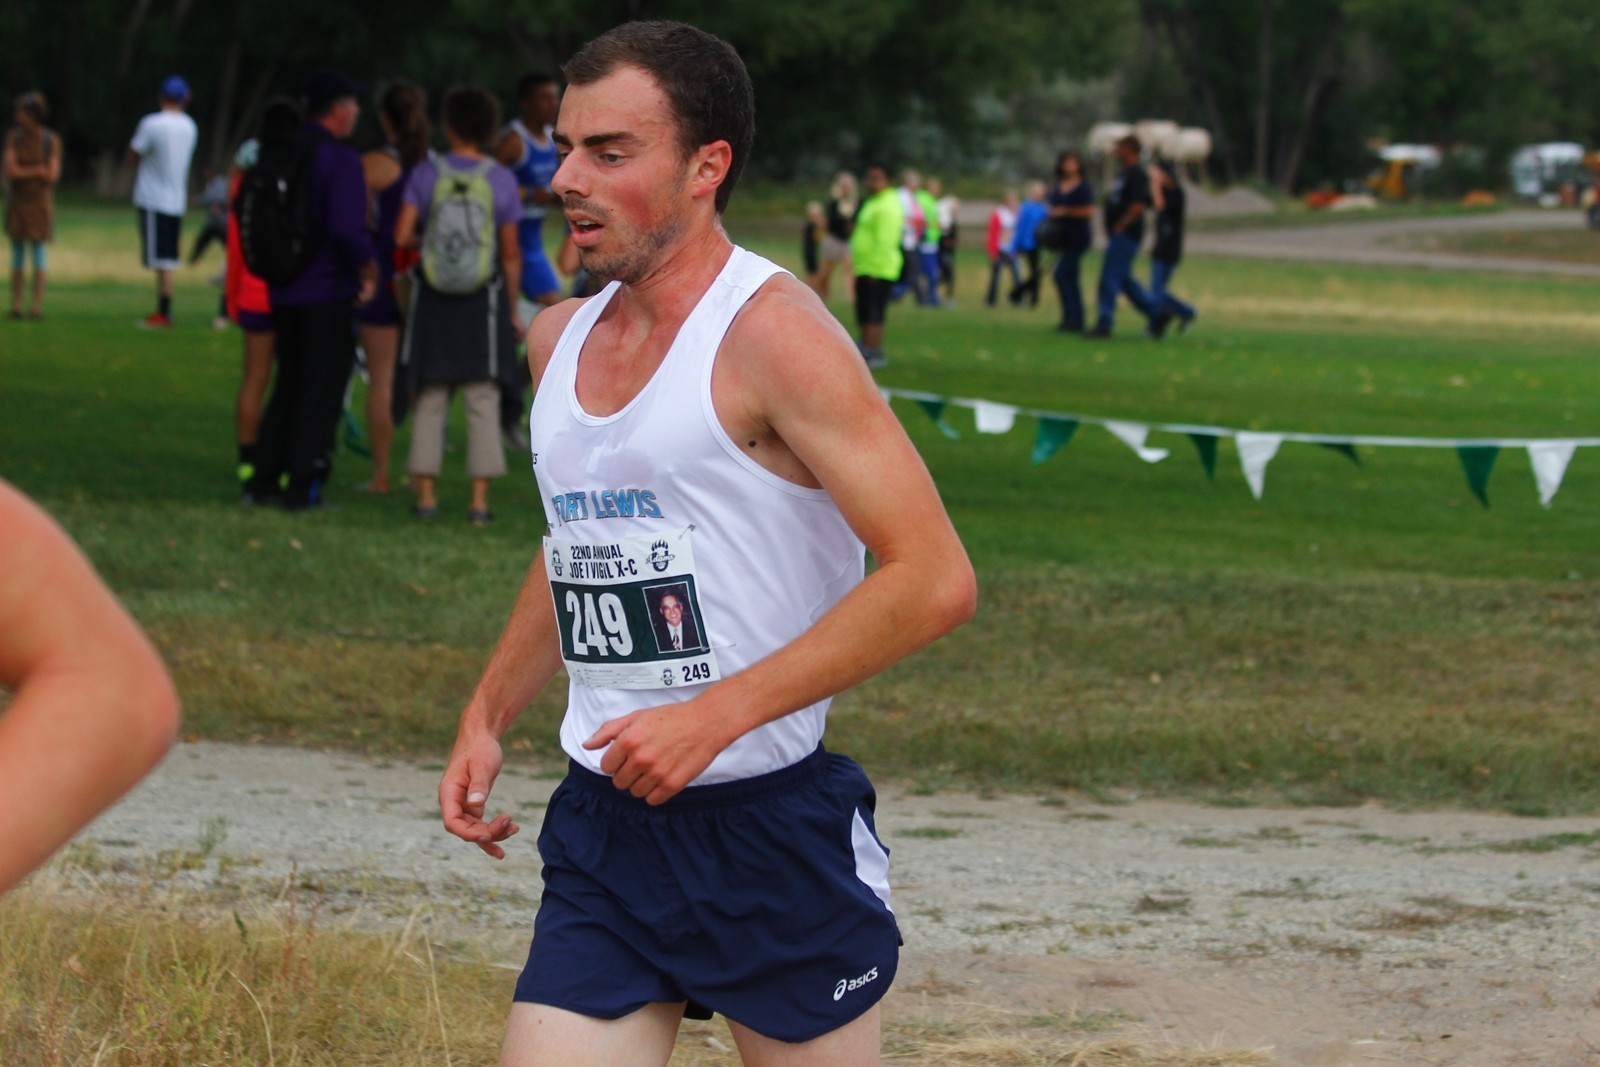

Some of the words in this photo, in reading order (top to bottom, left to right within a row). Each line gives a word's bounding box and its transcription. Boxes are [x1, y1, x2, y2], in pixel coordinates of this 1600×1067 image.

[591, 489, 665, 519] LEWIS
[571, 545, 592, 560] 22ND
[569, 562, 584, 579] JOE
[590, 562, 614, 579] VIGIL
[614, 558, 638, 578] X-C
[565, 590, 633, 657] 249
[682, 662, 711, 682] 249
[847, 966, 878, 991] asics
